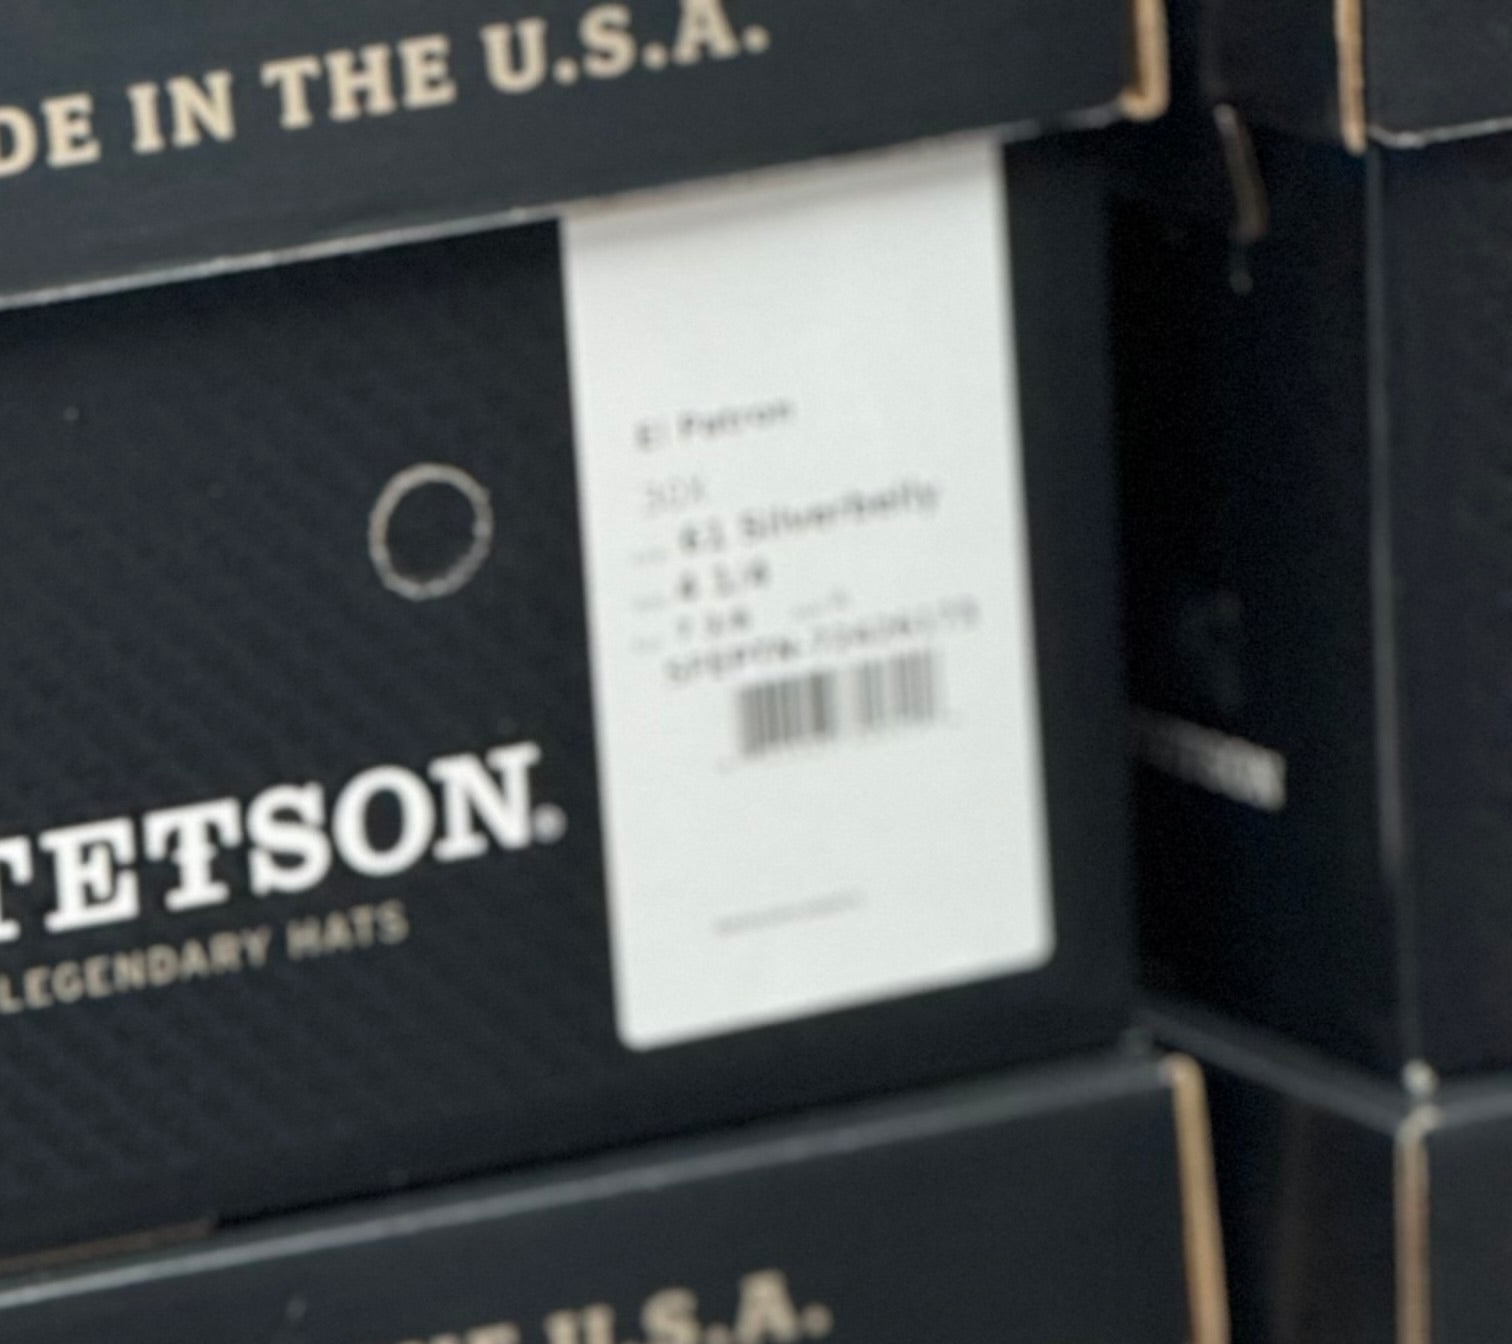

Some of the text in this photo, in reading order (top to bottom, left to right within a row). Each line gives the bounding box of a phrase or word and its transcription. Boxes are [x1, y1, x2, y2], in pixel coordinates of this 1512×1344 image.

[128, 70, 234, 154] IN
[260, 35, 455, 129] THE
[480, 0, 769, 92] U.S.A.
[287, 900, 410, 961] HATS
